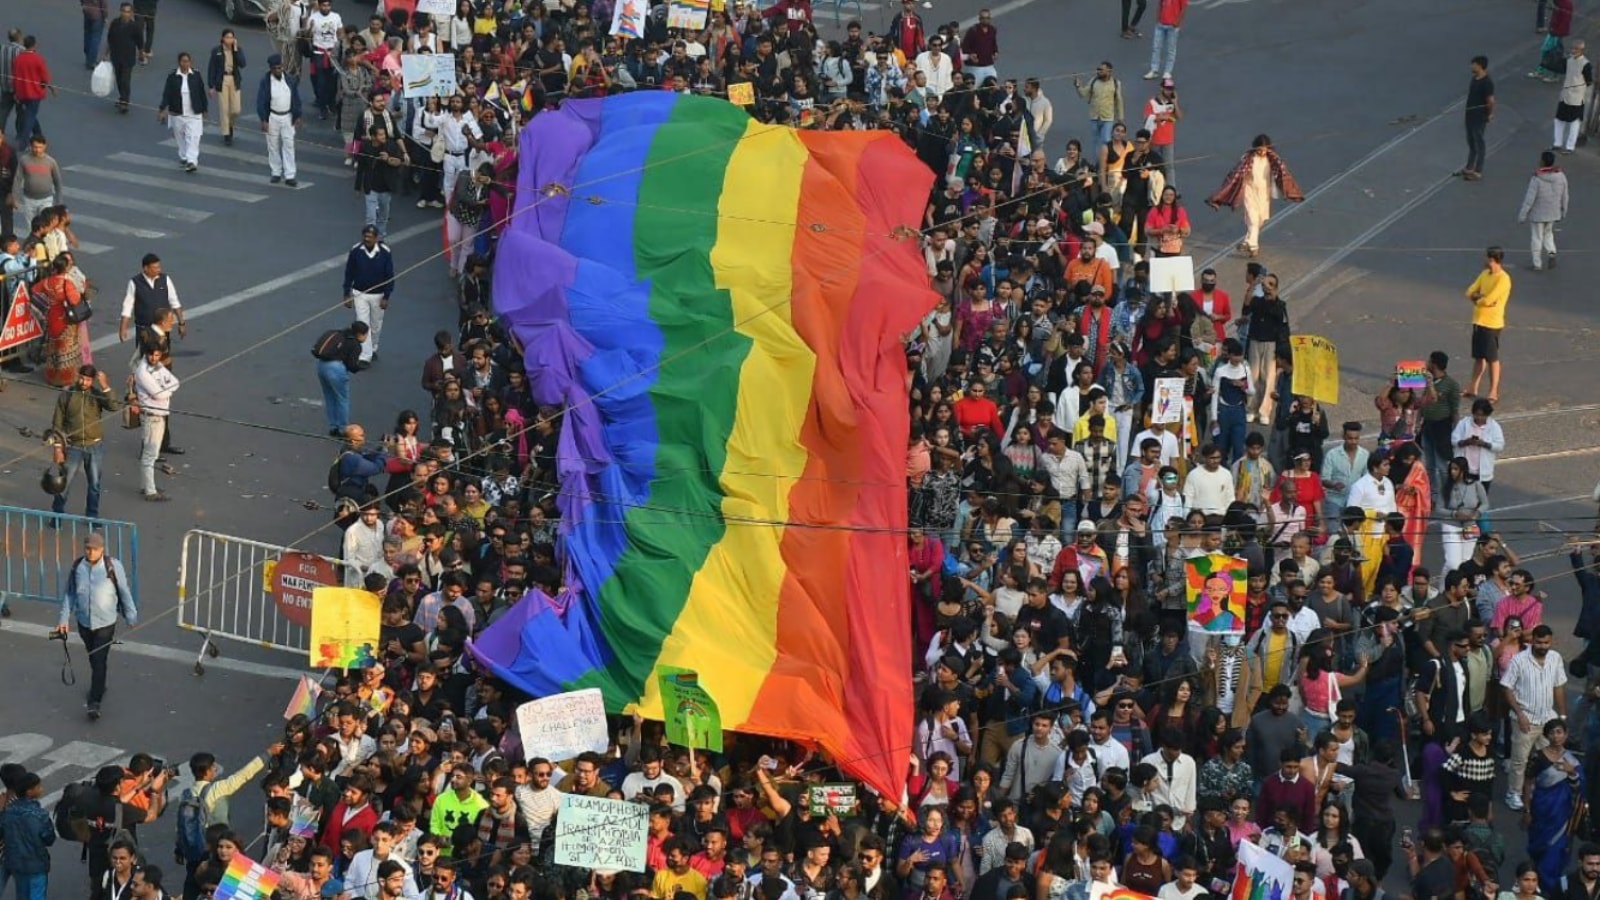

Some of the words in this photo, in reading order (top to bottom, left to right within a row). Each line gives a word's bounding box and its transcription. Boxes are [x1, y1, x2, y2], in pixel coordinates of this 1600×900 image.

[299, 563, 318, 575] FOR
[282, 593, 294, 605] NO
[295, 596, 313, 609] ENT
[567, 798, 649, 820] ISLAMOPHOBIA
